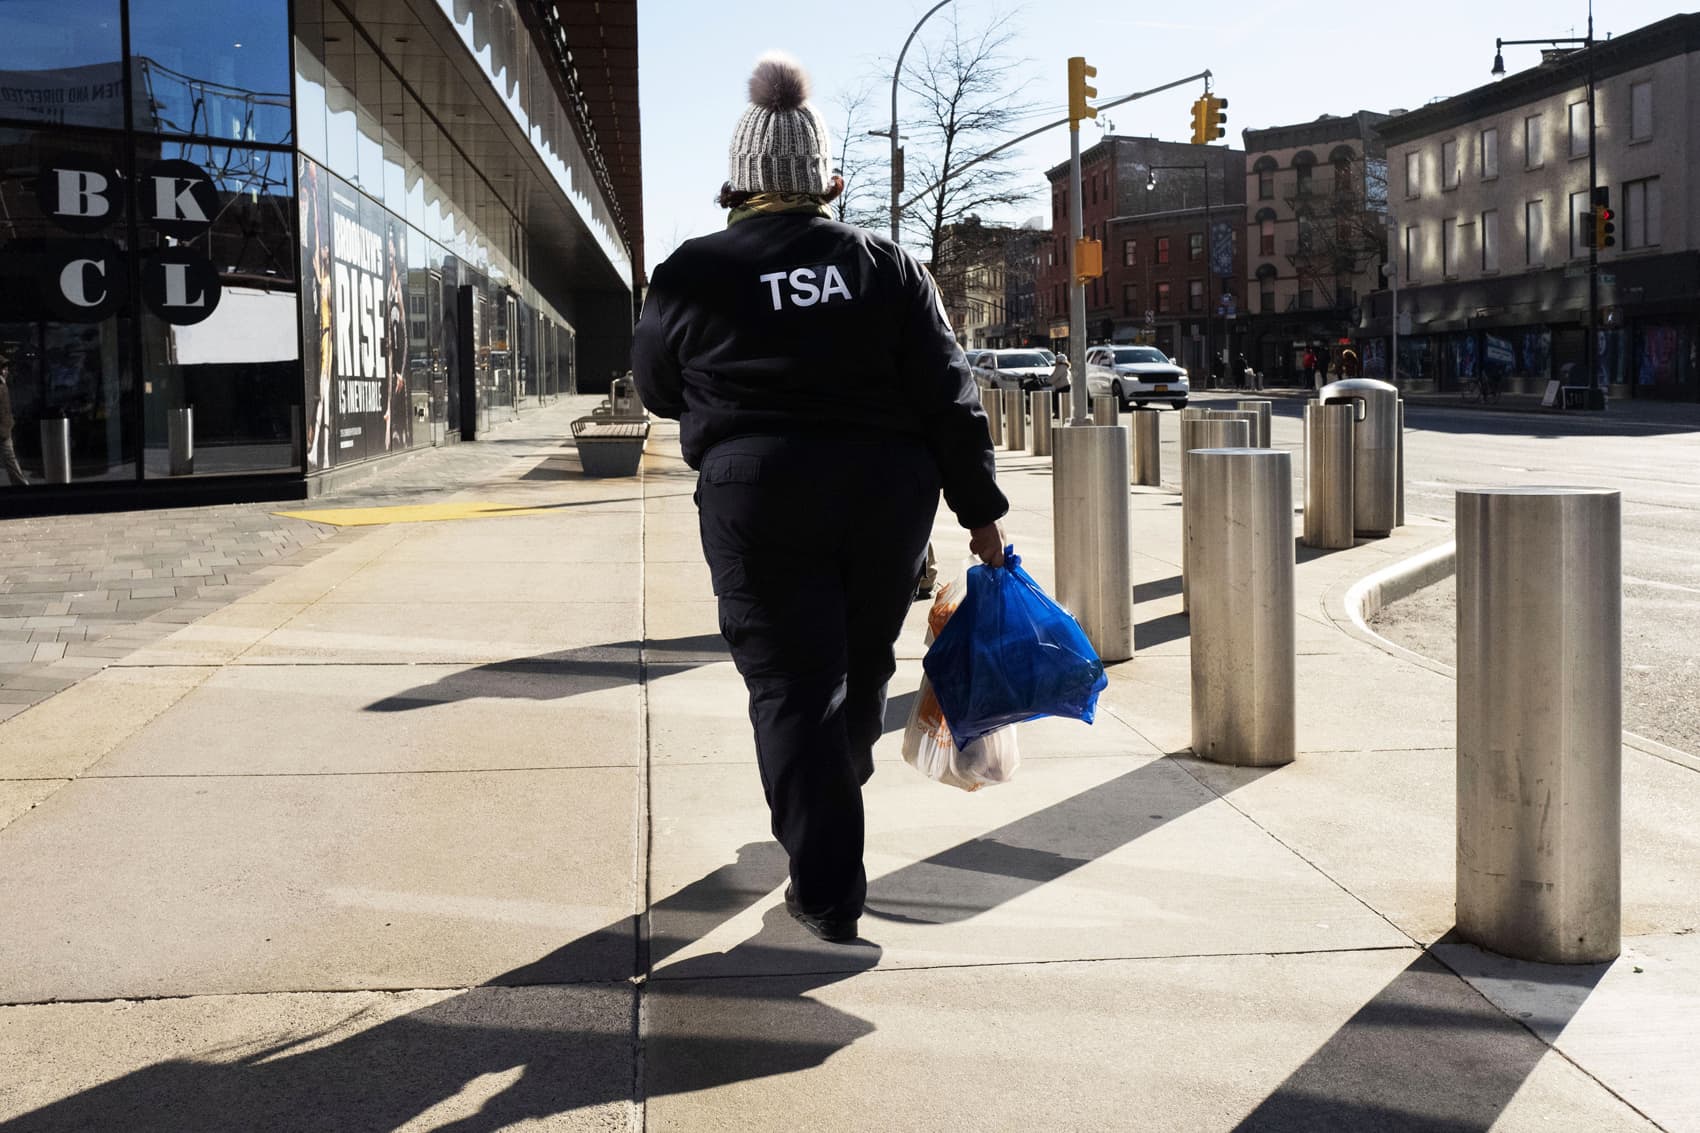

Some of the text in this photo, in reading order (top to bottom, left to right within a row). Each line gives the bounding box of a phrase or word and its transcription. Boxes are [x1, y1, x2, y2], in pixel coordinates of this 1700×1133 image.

[760, 265, 853, 311] TSA
[334, 261, 386, 379] RISE
[338, 380, 383, 414] IS INEVITABLE
